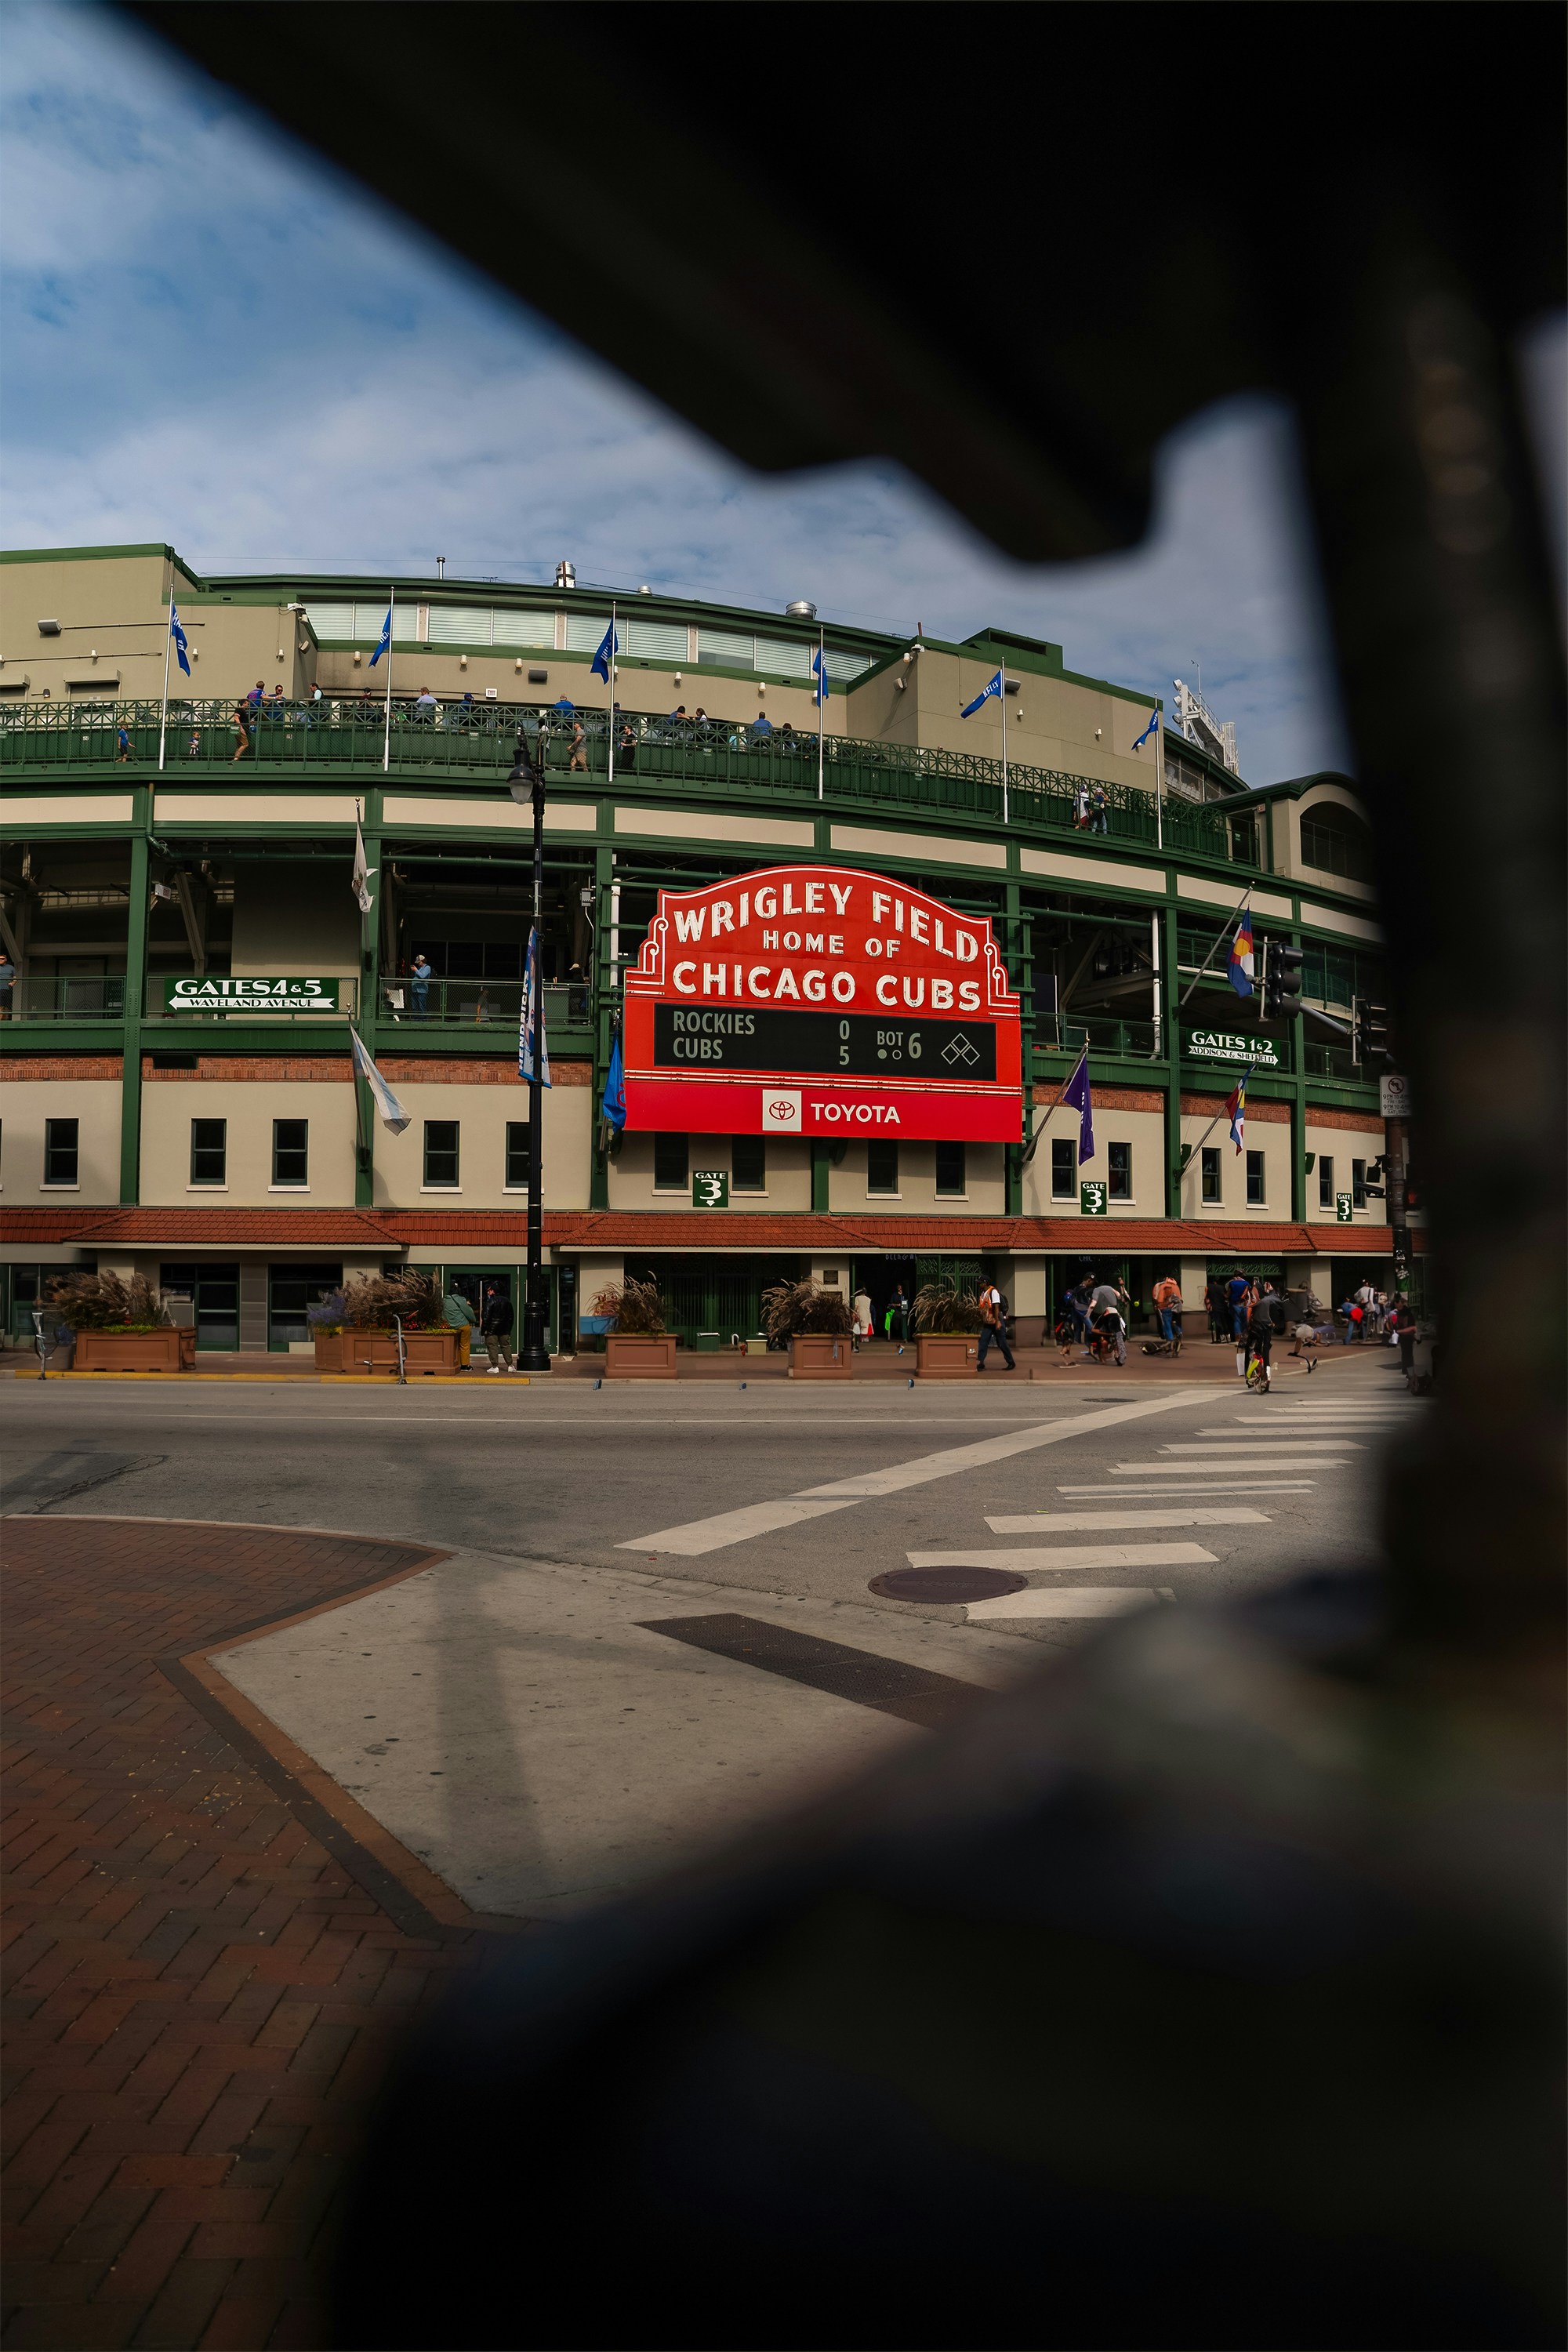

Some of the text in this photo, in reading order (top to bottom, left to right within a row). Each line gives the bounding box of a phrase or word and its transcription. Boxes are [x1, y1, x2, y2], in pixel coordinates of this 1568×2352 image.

[673, 882, 979, 963] WRIGLEY FIELD
[762, 929, 901, 958] HOME OF
[175, 979, 270, 996] GATES
[673, 961, 981, 1011] CHICAGO CUBS
[189, 998, 315, 1007] WAVELAND AVENUE
[673, 1011, 850, 1040] ROCKIES 0
[673, 1036, 850, 1065] CUBS 5
[877, 1030, 922, 1059] BOT 6
[1192, 1032, 1246, 1050] GATES
[1192, 1047, 1228, 1057] ADDISON
[810, 1103, 901, 1123] TOYOTA
[699, 1179, 722, 1200] 3
[1085, 1189, 1102, 1207] 3
[1339, 1200, 1350, 1216] 3
